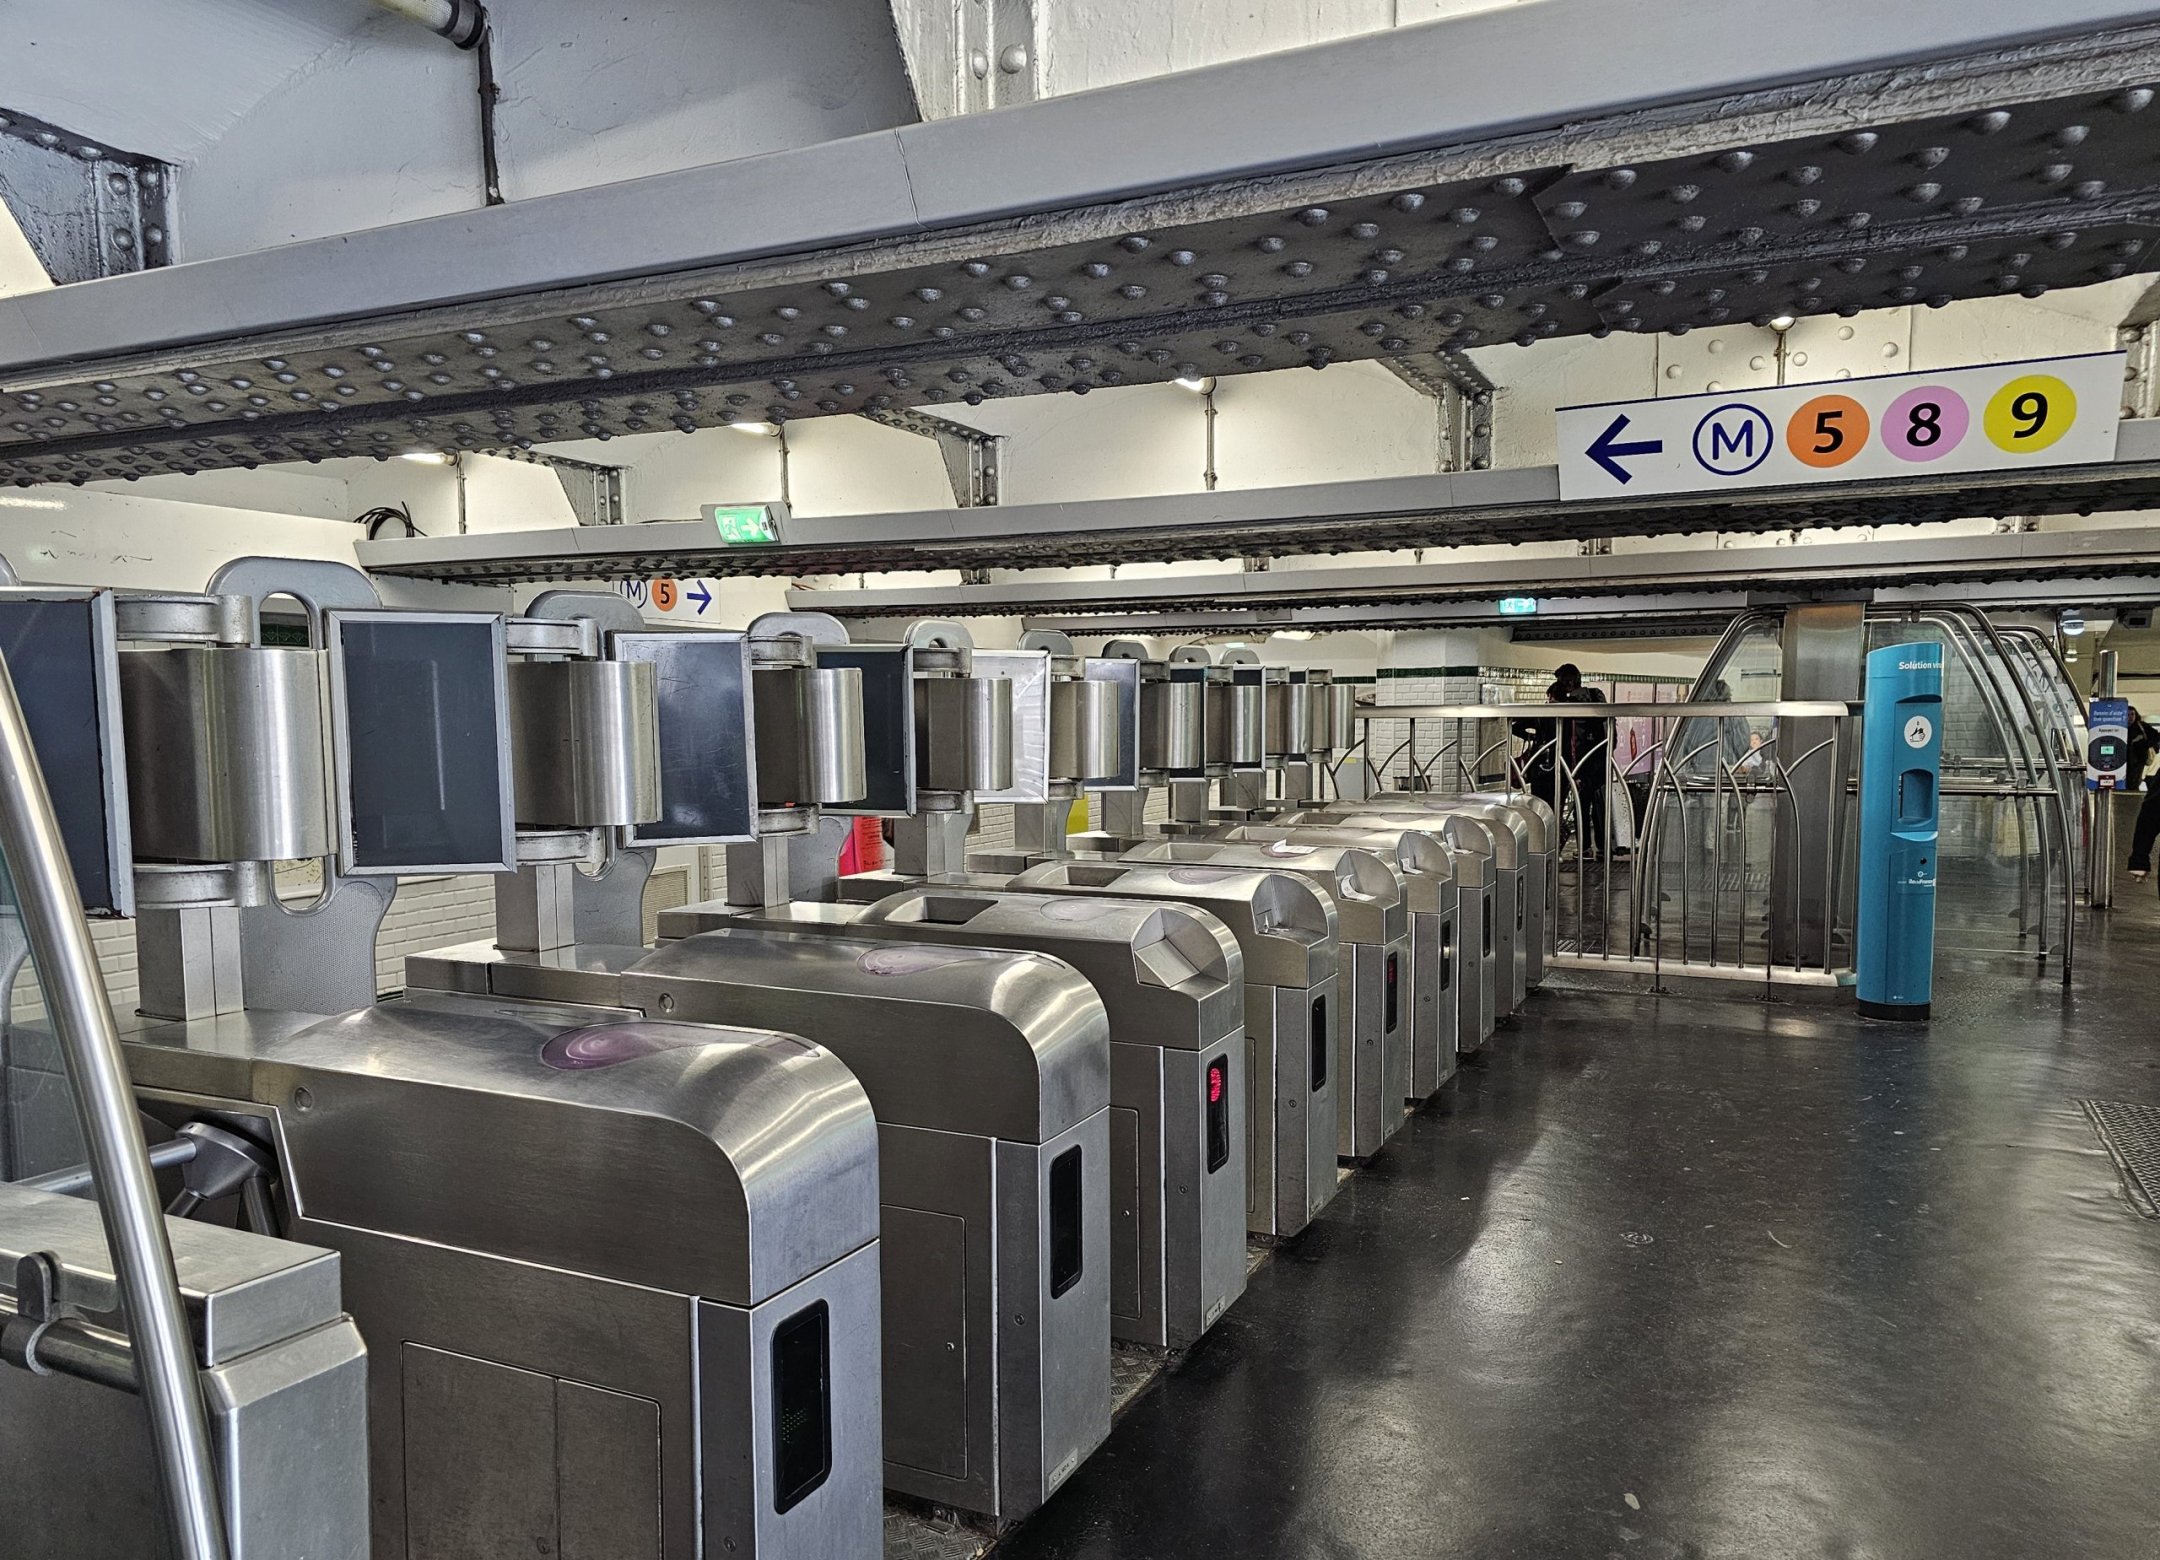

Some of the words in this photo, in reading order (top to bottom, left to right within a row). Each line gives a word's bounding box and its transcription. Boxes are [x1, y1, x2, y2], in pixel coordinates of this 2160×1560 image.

[1712, 419, 1754, 459] M
[1812, 410, 1845, 455] 5
[1906, 402, 1942, 447] 8
[2010, 391, 2049, 439] 9
[627, 579, 641, 601] M
[660, 583, 670, 604] 5
[1899, 661, 1932, 670] Solution
